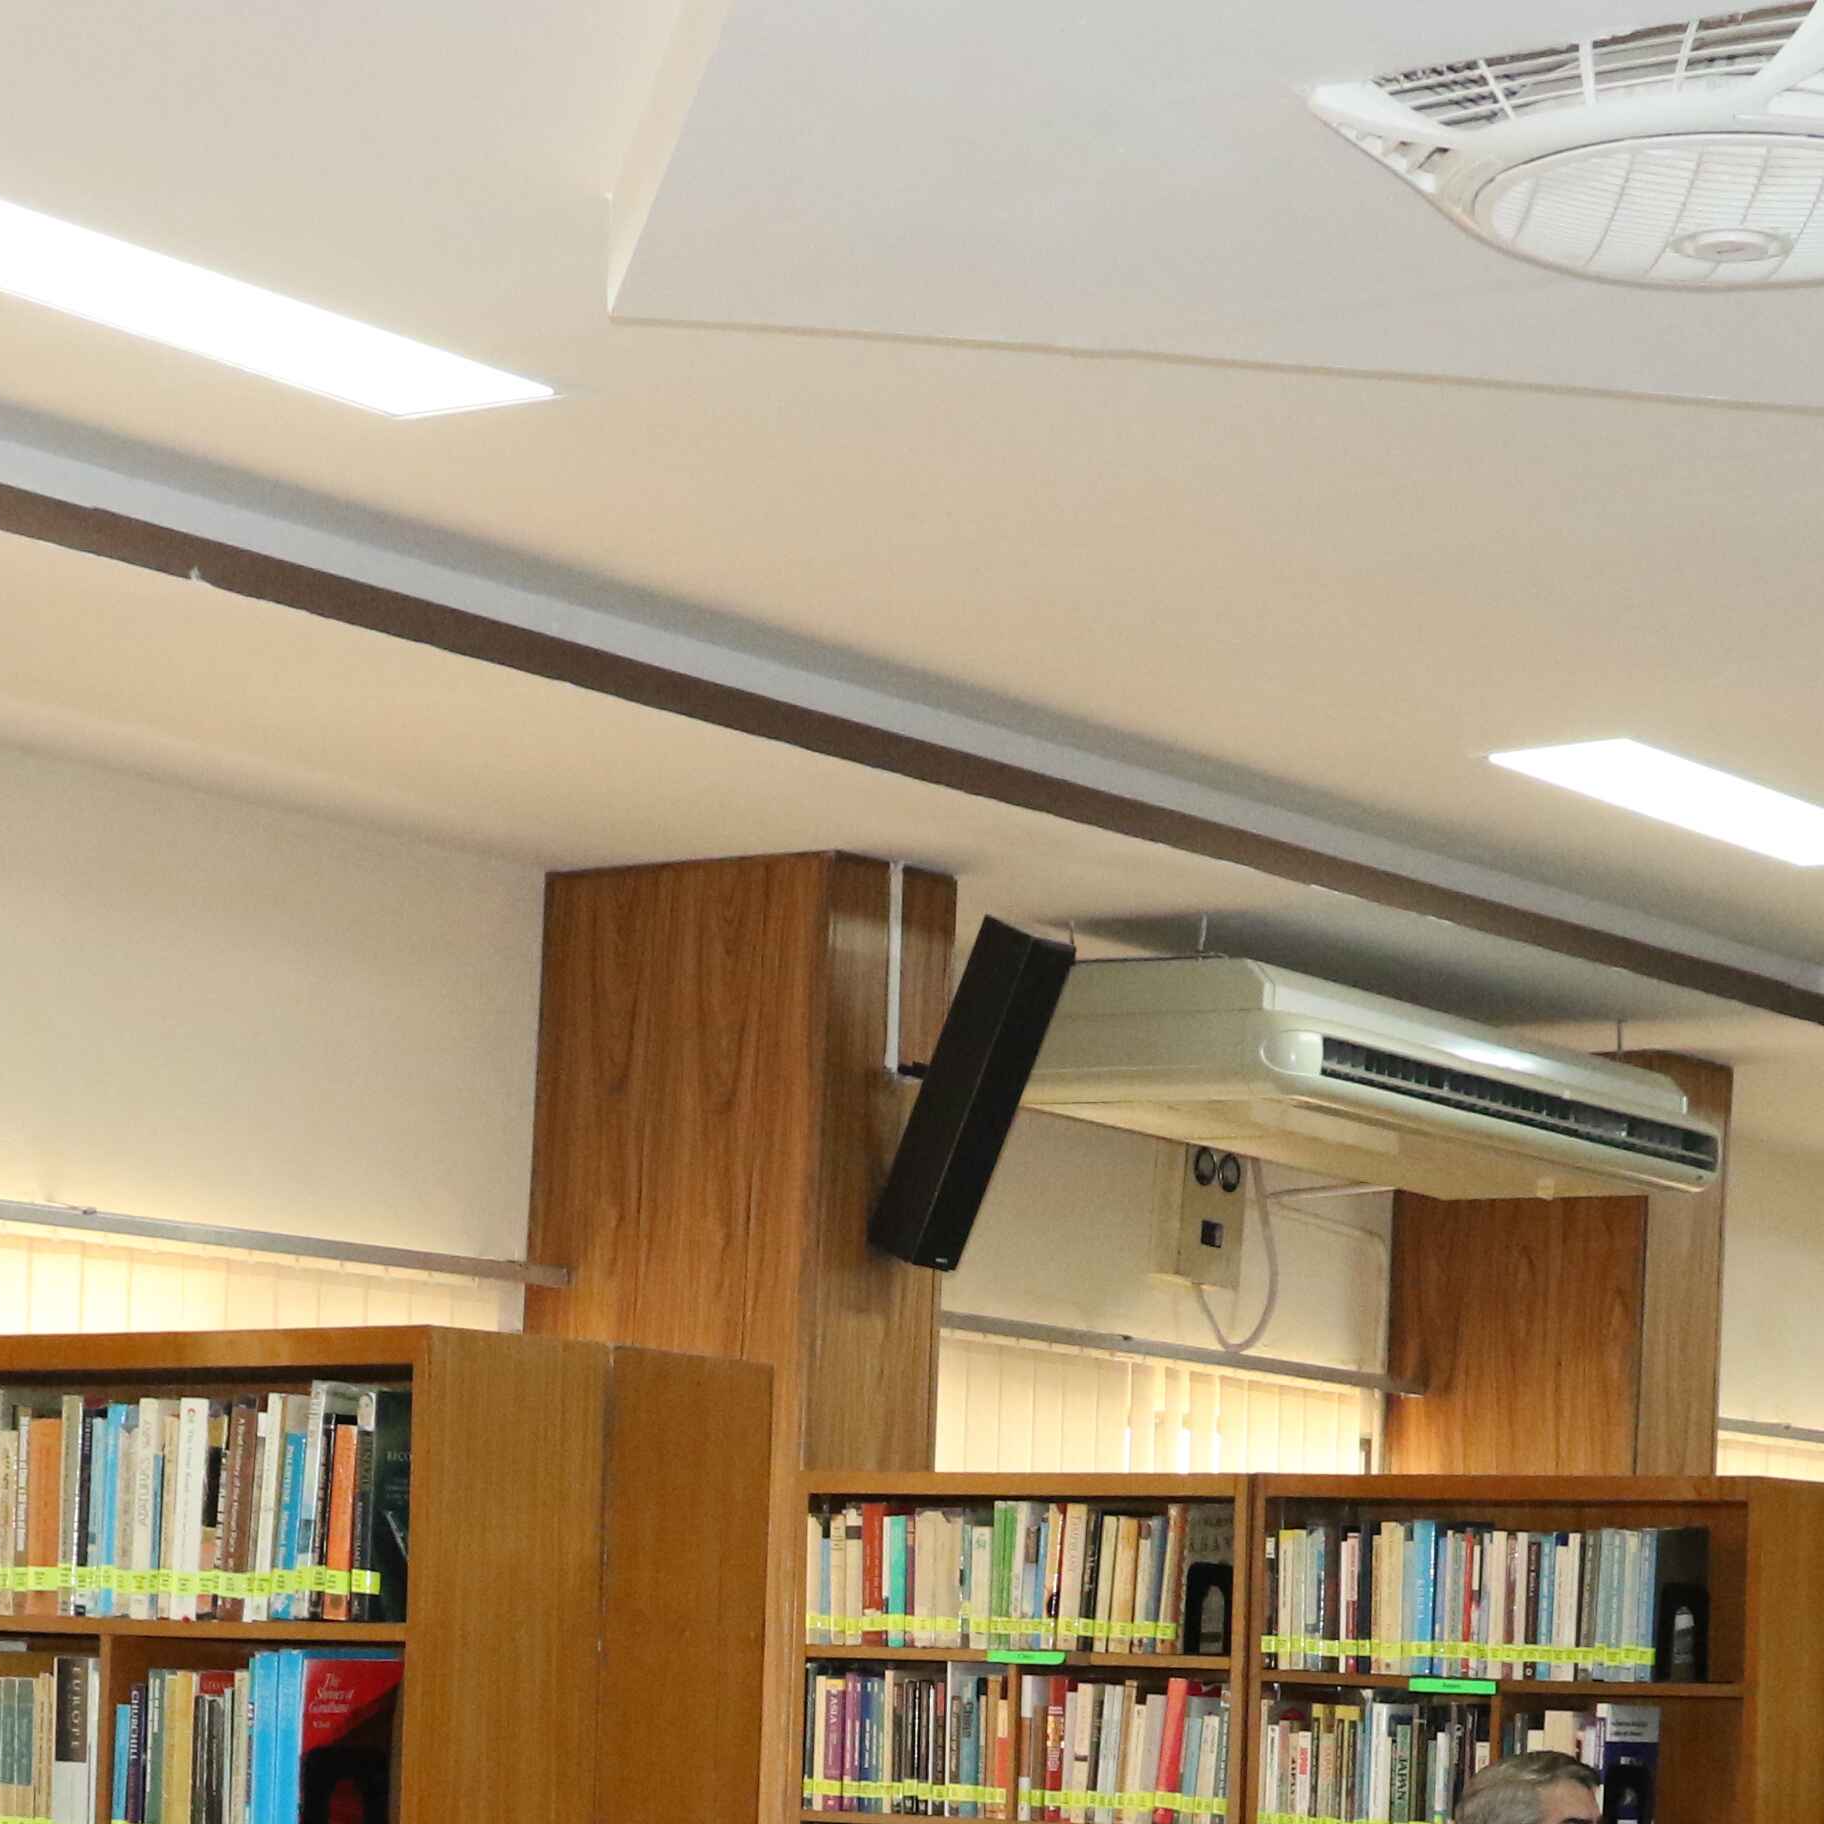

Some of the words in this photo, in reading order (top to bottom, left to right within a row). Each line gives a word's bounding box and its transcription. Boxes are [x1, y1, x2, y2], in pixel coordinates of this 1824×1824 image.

[71, 1667, 82, 1749] EUROPE
[129, 1690, 141, 1762] CHURCHILL
[829, 1696, 838, 1724] ASIA
[1396, 1757, 1409, 1801] JAPAN
